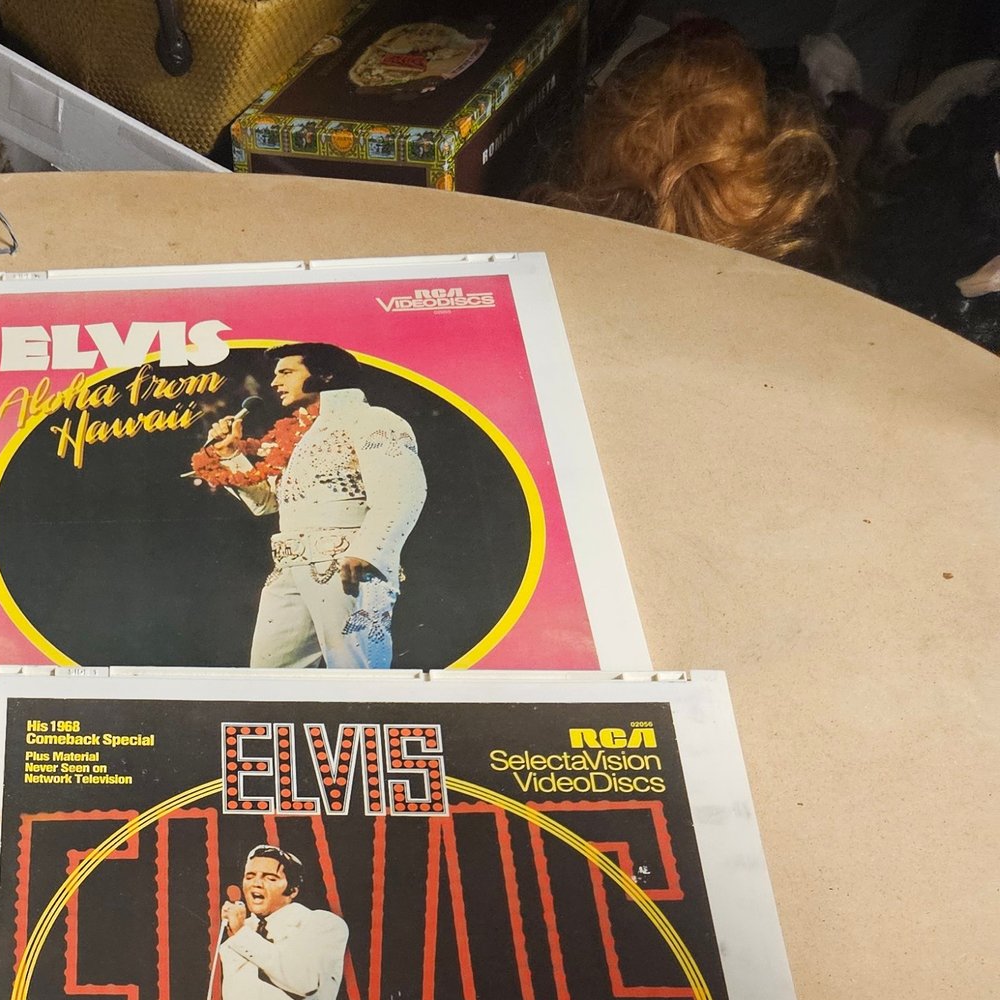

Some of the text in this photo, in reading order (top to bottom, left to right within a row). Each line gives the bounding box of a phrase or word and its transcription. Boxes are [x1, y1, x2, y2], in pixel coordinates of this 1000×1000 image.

[414, 287, 464, 299] RCA
[0, 319, 233, 372] ELVIS
[125, 363, 229, 407] from
[50, 400, 206, 469] Hawaii
[26, 719, 81, 733] His 1968
[26, 732, 155, 748] Comeback Special
[569, 728, 657, 749] RCA
[25, 751, 100, 762] Plus Material
[489, 750, 662, 771] SelectaVision
[24, 762, 108, 773] Never Seen on
[221, 722, 450, 817] ELVIS
[24, 773, 133, 785] Network Television
[513, 771, 666, 793] VideoDiscs
